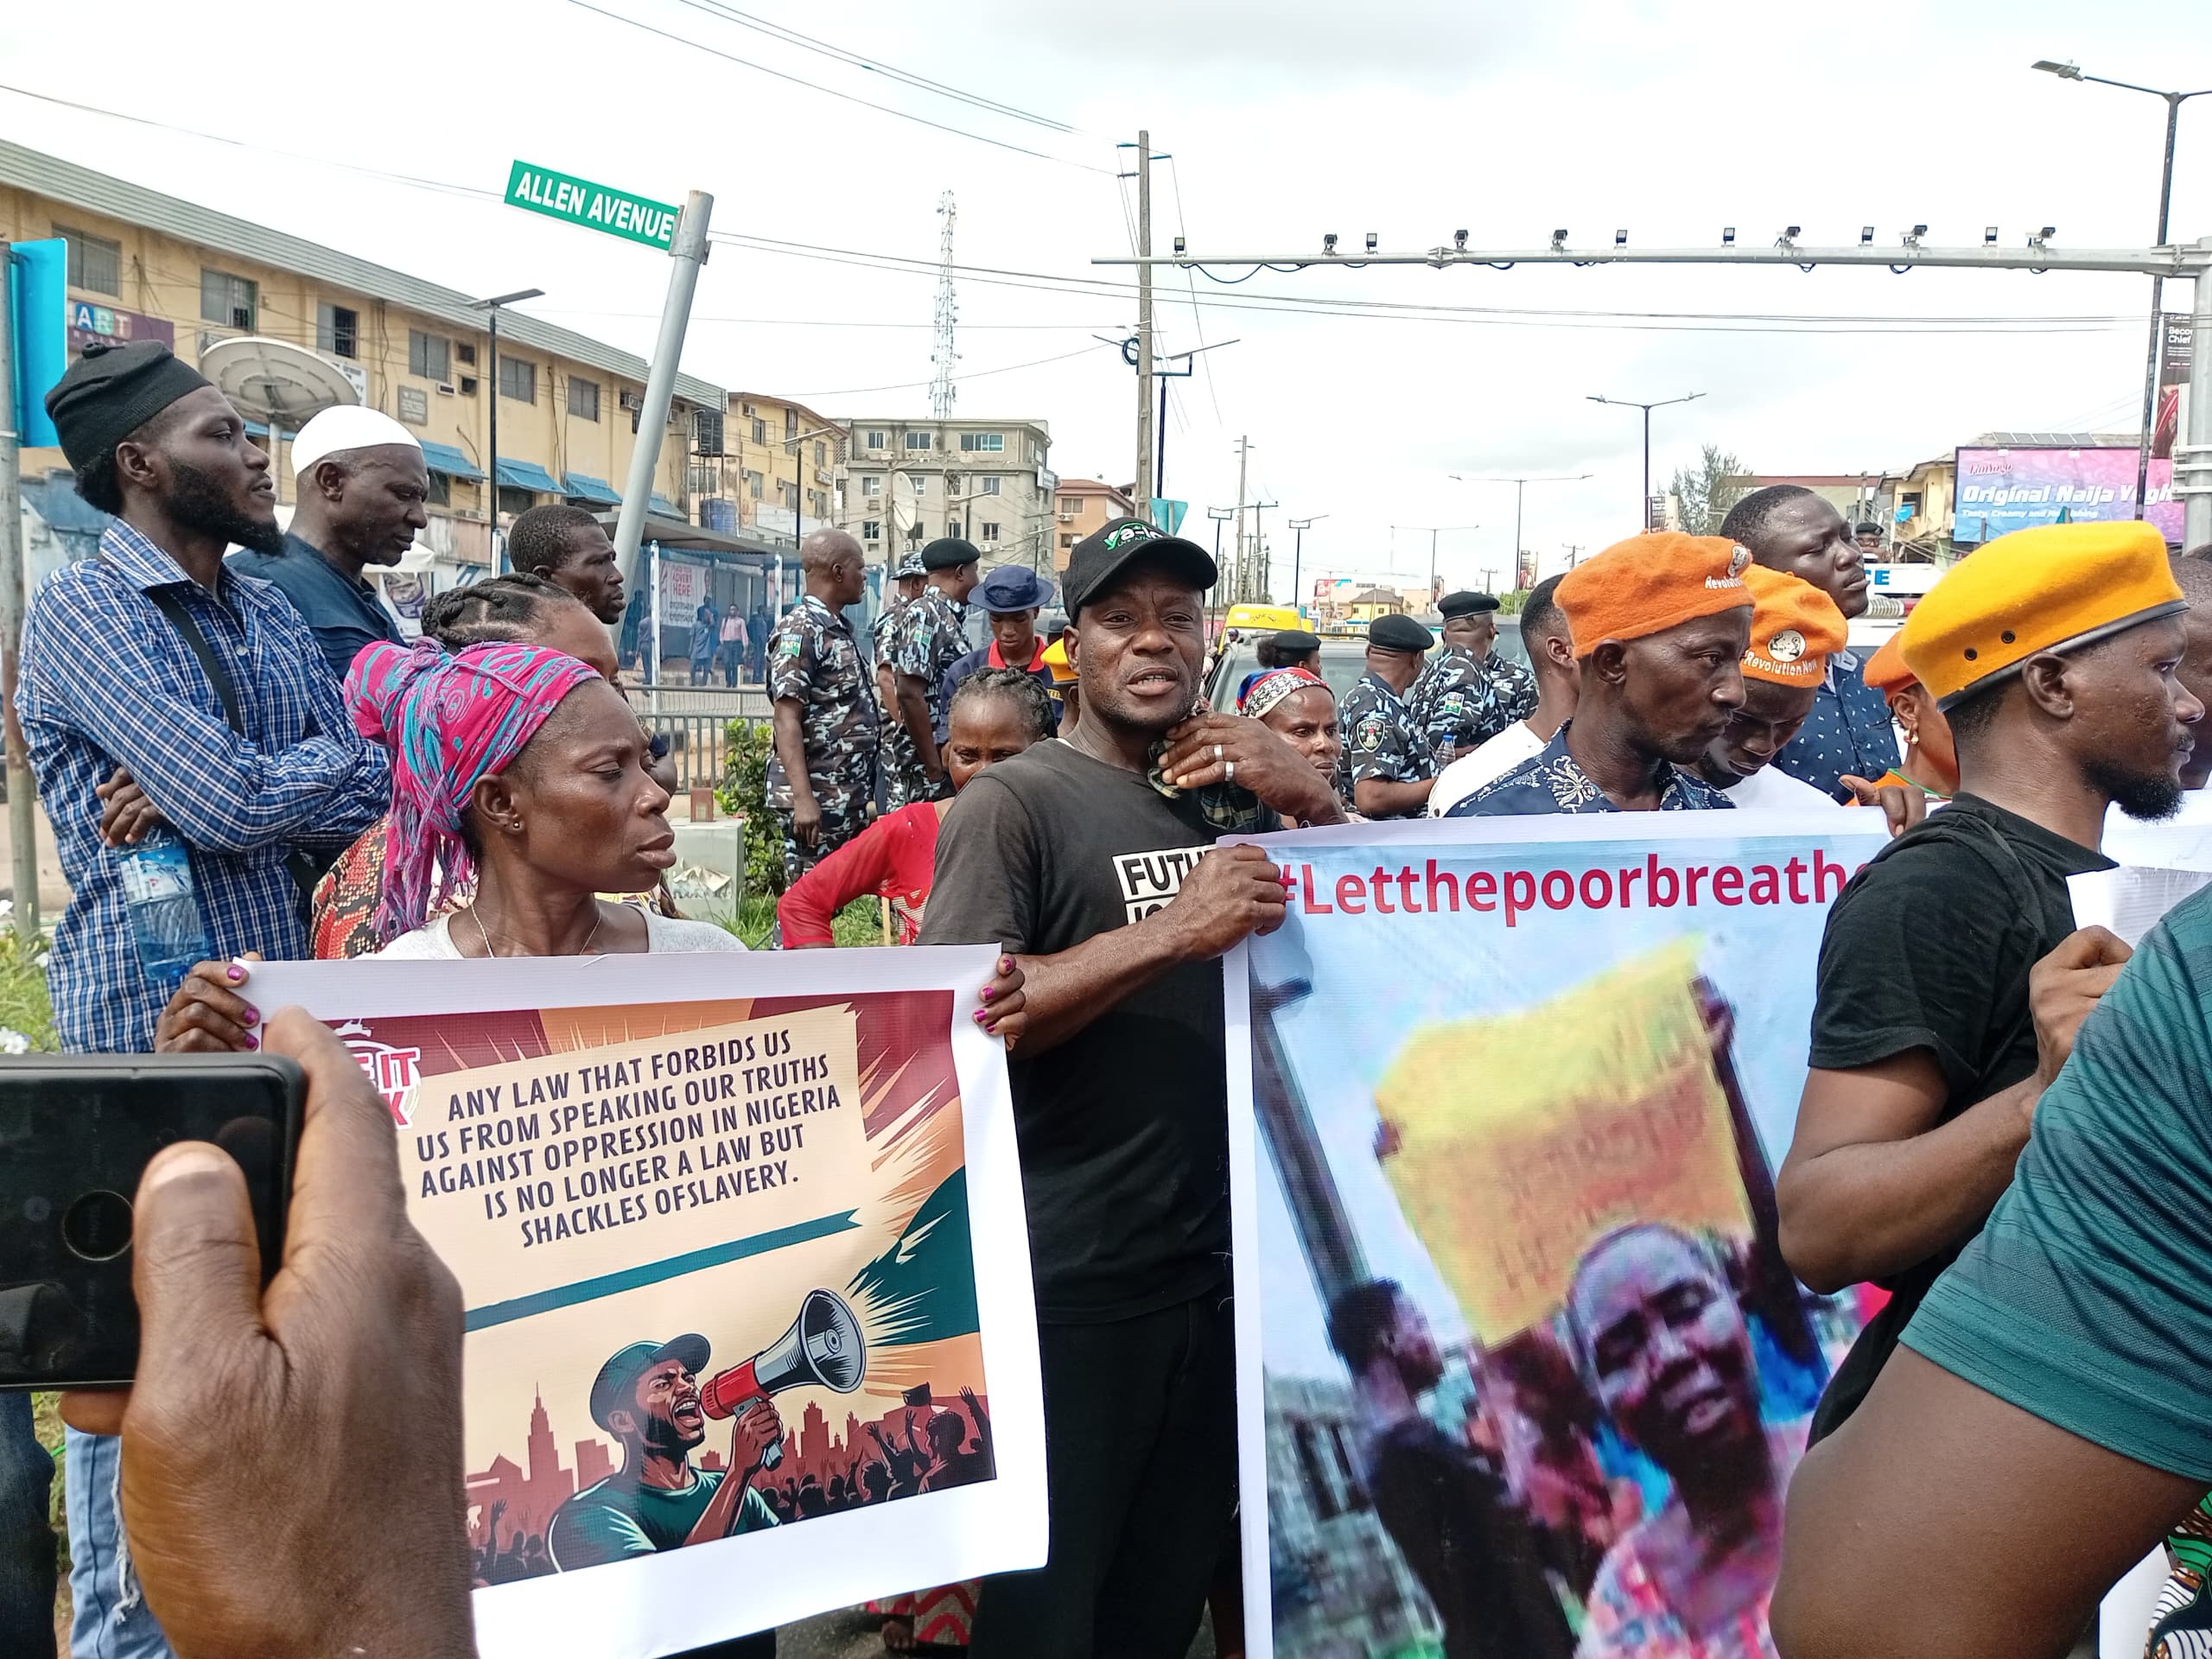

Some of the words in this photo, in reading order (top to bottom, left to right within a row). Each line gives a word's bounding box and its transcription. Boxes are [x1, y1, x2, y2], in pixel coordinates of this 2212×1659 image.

[514, 171, 587, 216] ALLEN
[587, 193, 677, 243] AVENUE
[1961, 484, 2052, 507] Original
[2056, 484, 2115, 507] Naija
[1279, 849, 1869, 928] #Letthepoorbreath
[416, 1131, 449, 1162] US
[460, 1113, 540, 1154] FROM
[550, 1085, 677, 1135] SPEAKING
[685, 1073, 736, 1106] OUR
[742, 1054, 830, 1094] TRUTHS
[448, 1085, 502, 1122] ANY
[512, 1072, 569, 1108] LAW
[578, 1058, 642, 1094] THAT
[652, 1036, 756, 1080] FORBIDS
[764, 1029, 791, 1058] US
[422, 1149, 534, 1198] AGAINST
[544, 1113, 704, 1171] OPPRESSION
[712, 1106, 738, 1135] IN
[746, 1084, 841, 1127] NIGERIA
[485, 1191, 508, 1220] IS
[517, 1181, 554, 1213] NO
[564, 1155, 670, 1202] LONGER
[678, 1150, 693, 1176] A
[700, 1135, 751, 1170] LAW
[760, 1123, 804, 1157] BUT
[520, 1194, 647, 1248] SHACKLES
